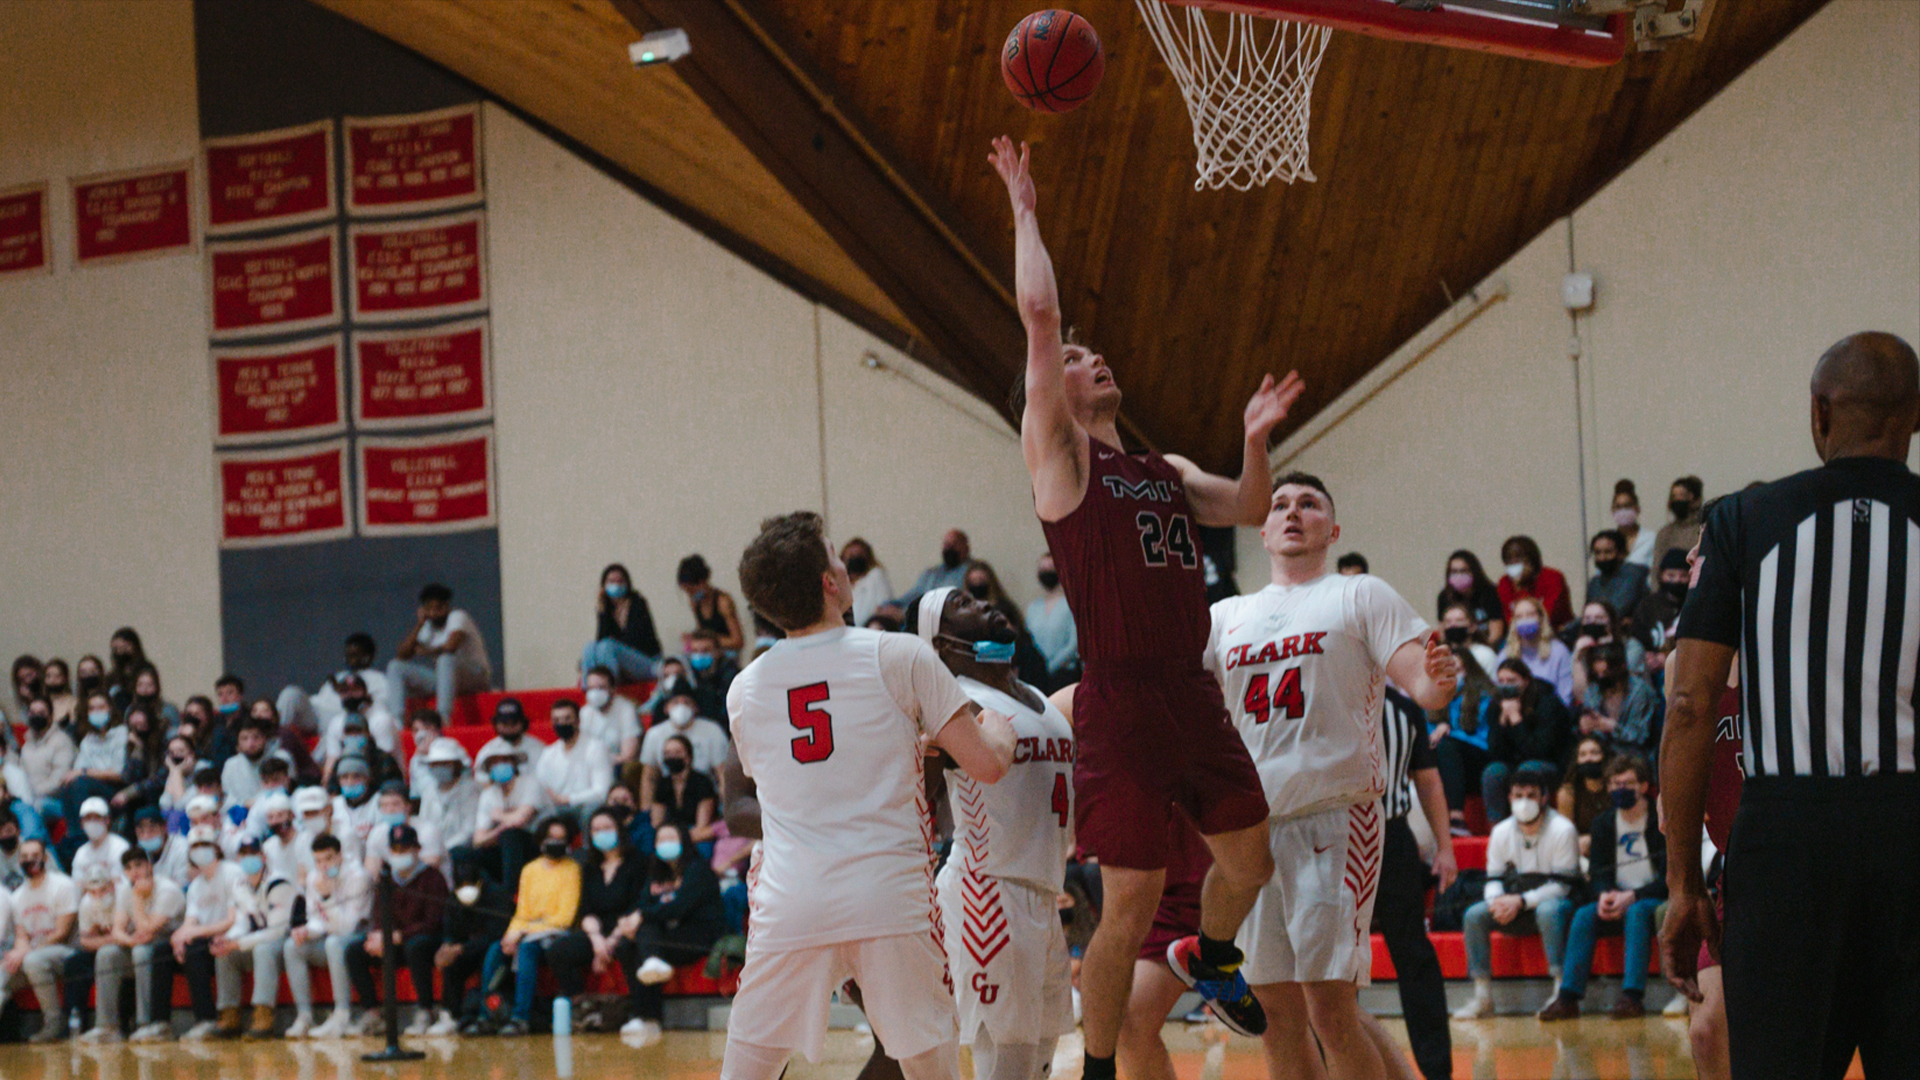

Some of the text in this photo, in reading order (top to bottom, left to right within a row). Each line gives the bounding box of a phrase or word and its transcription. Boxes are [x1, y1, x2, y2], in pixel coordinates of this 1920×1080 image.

[1136, 510, 1198, 570] 24
[1226, 631, 1328, 672] CLARK
[787, 680, 834, 764] 5
[1244, 666, 1305, 725] 44
[1012, 736, 1075, 764] CLAR
[1051, 772, 1070, 828] 4
[971, 971, 1000, 1005] CU
